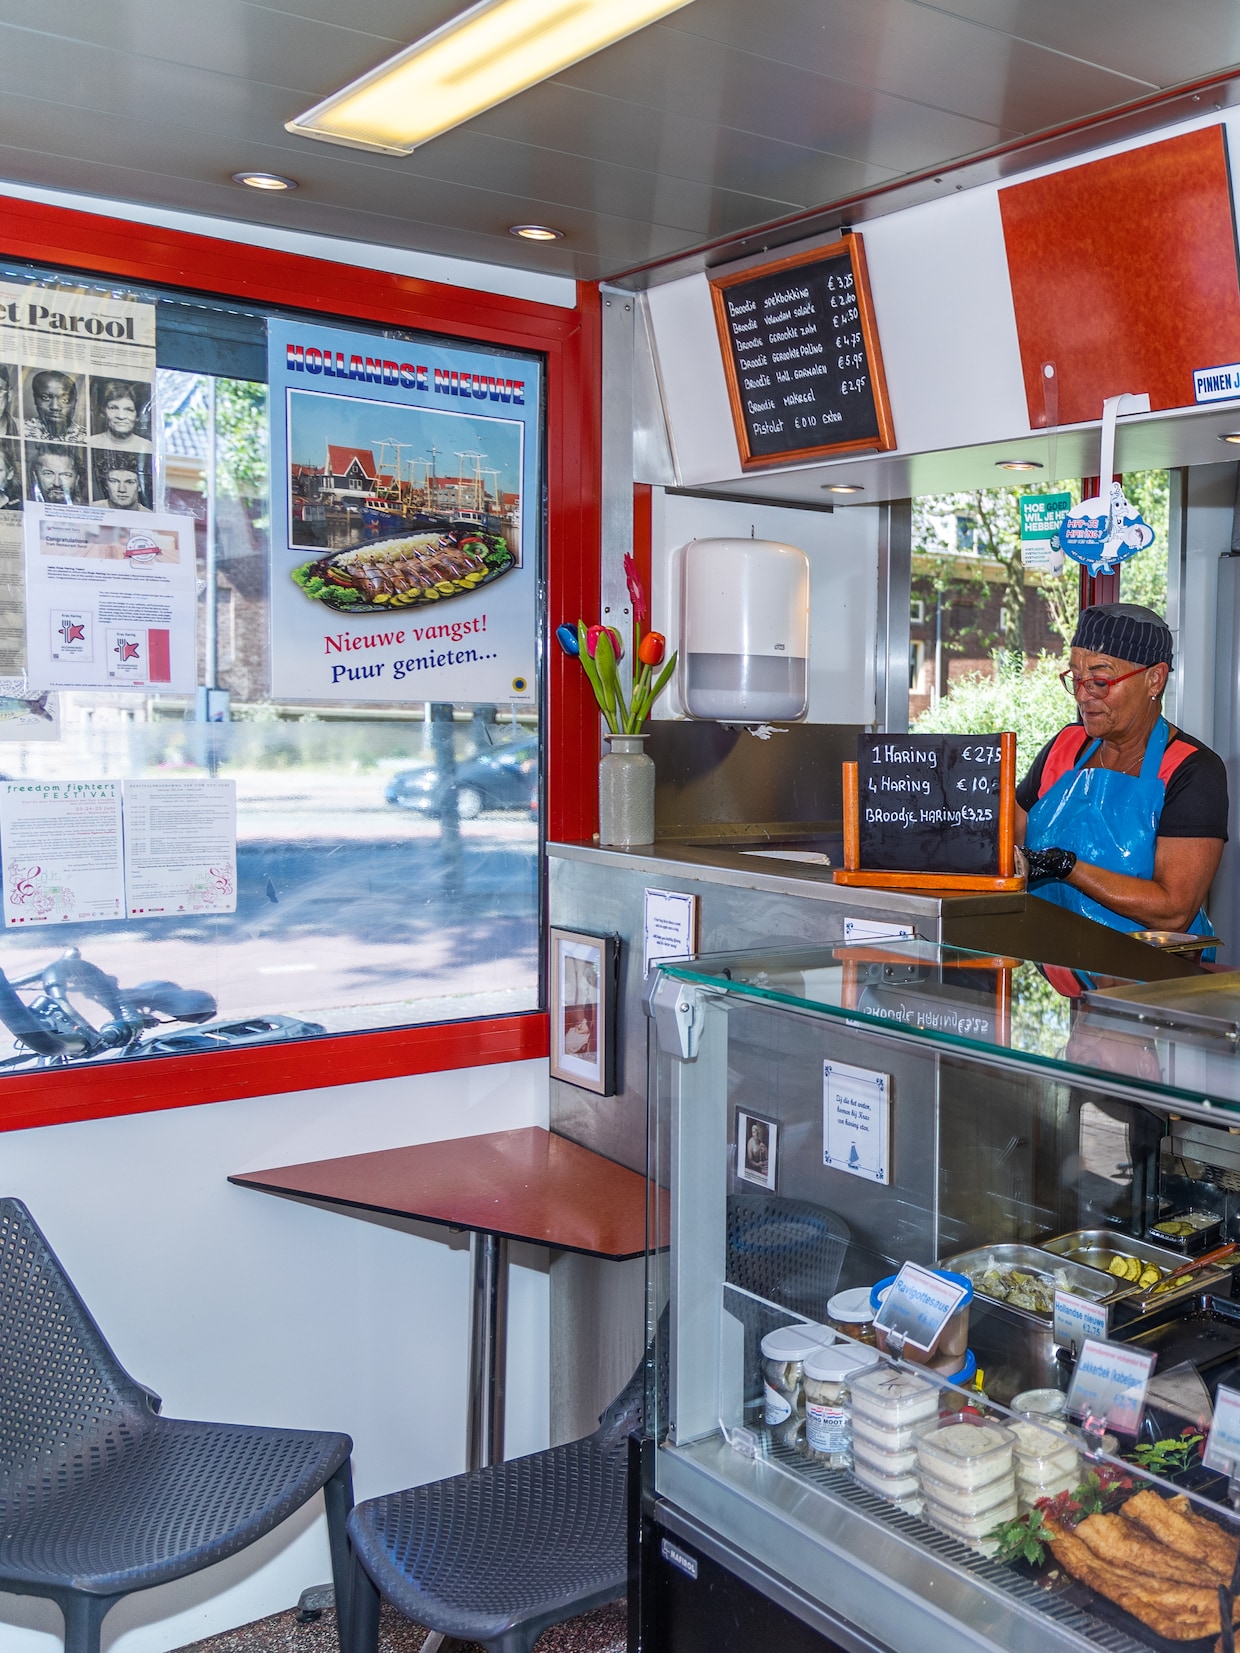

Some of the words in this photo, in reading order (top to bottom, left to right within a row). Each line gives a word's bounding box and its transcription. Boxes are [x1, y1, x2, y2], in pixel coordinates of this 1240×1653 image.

[28, 303, 135, 340] Parool
[286, 343, 429, 392] HOLLANDSE
[434, 368, 525, 406] NIEUWE
[1197, 374, 1232, 394] PINNEN
[1024, 503, 1044, 513] HOE
[1047, 501, 1067, 511] GOED
[1024, 513, 1042, 522] WIL
[1044, 511, 1053, 521] JE
[324, 630, 405, 654] Nieuwe
[413, 614, 487, 642] vangst!
[331, 662, 385, 684] Puur
[393, 648, 498, 680] genieten...
[872, 746, 882, 764] 1
[885, 744, 937, 769] HARING
[961, 746, 972, 762] €
[7, 785, 60, 794] freedom
[67, 783, 115, 792] fighters
[868, 777, 877, 794] 4
[881, 774, 931, 795] HARING
[956, 778, 967, 791] €
[920, 806, 962, 827] HARING
[895, 1280, 950, 1313] Ravigottesaus
[1055, 1303, 1083, 1320] Hollandse
[1084, 1313, 1104, 1328] nieuwe
